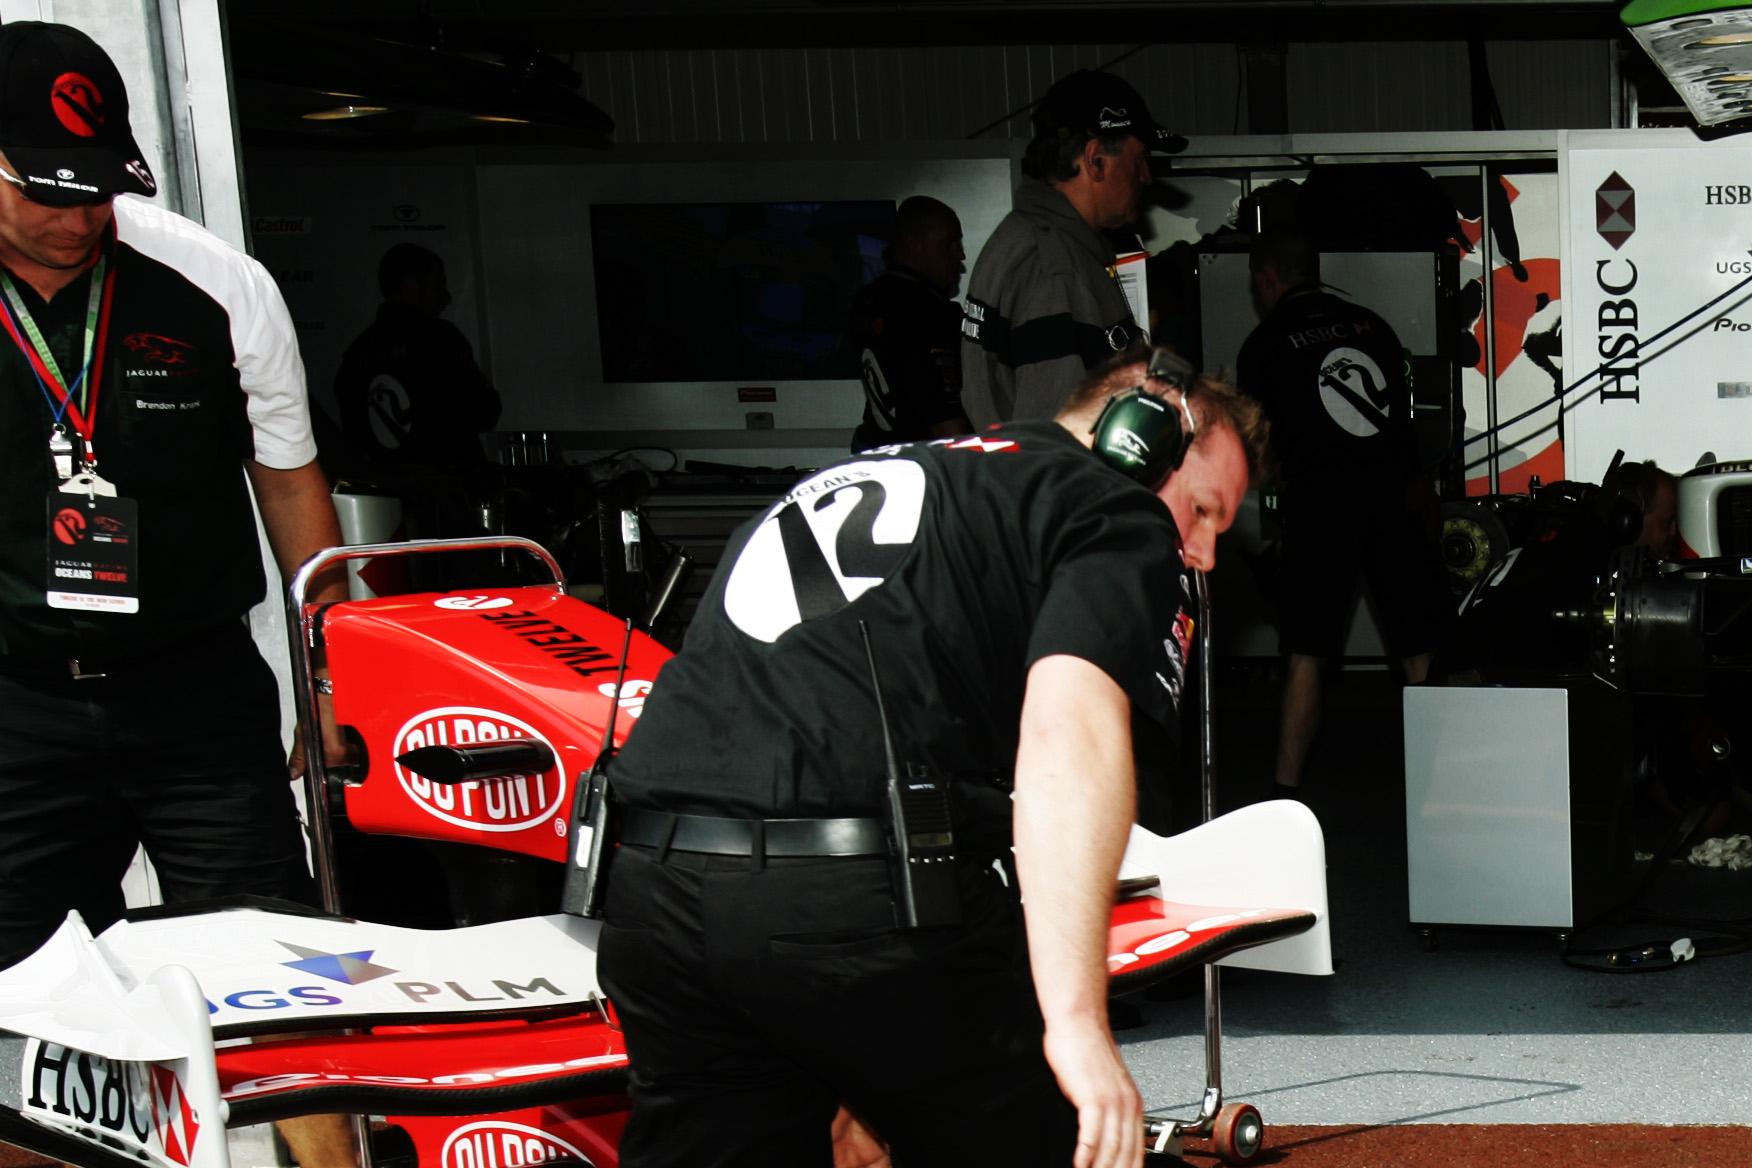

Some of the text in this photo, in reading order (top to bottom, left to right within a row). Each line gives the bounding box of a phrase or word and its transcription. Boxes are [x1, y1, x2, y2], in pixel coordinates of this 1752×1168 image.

[255, 217, 304, 233] Castrol
[1716, 261, 1752, 274] UGS
[1287, 323, 1348, 349] HSBC
[1595, 257, 1640, 404] HSBC
[126, 369, 168, 378] JAGUAR
[477, 610, 630, 677] TWELVE
[203, 986, 345, 1016] GS
[394, 977, 568, 1004] PLM
[231, 1052, 630, 1093] Pionee
